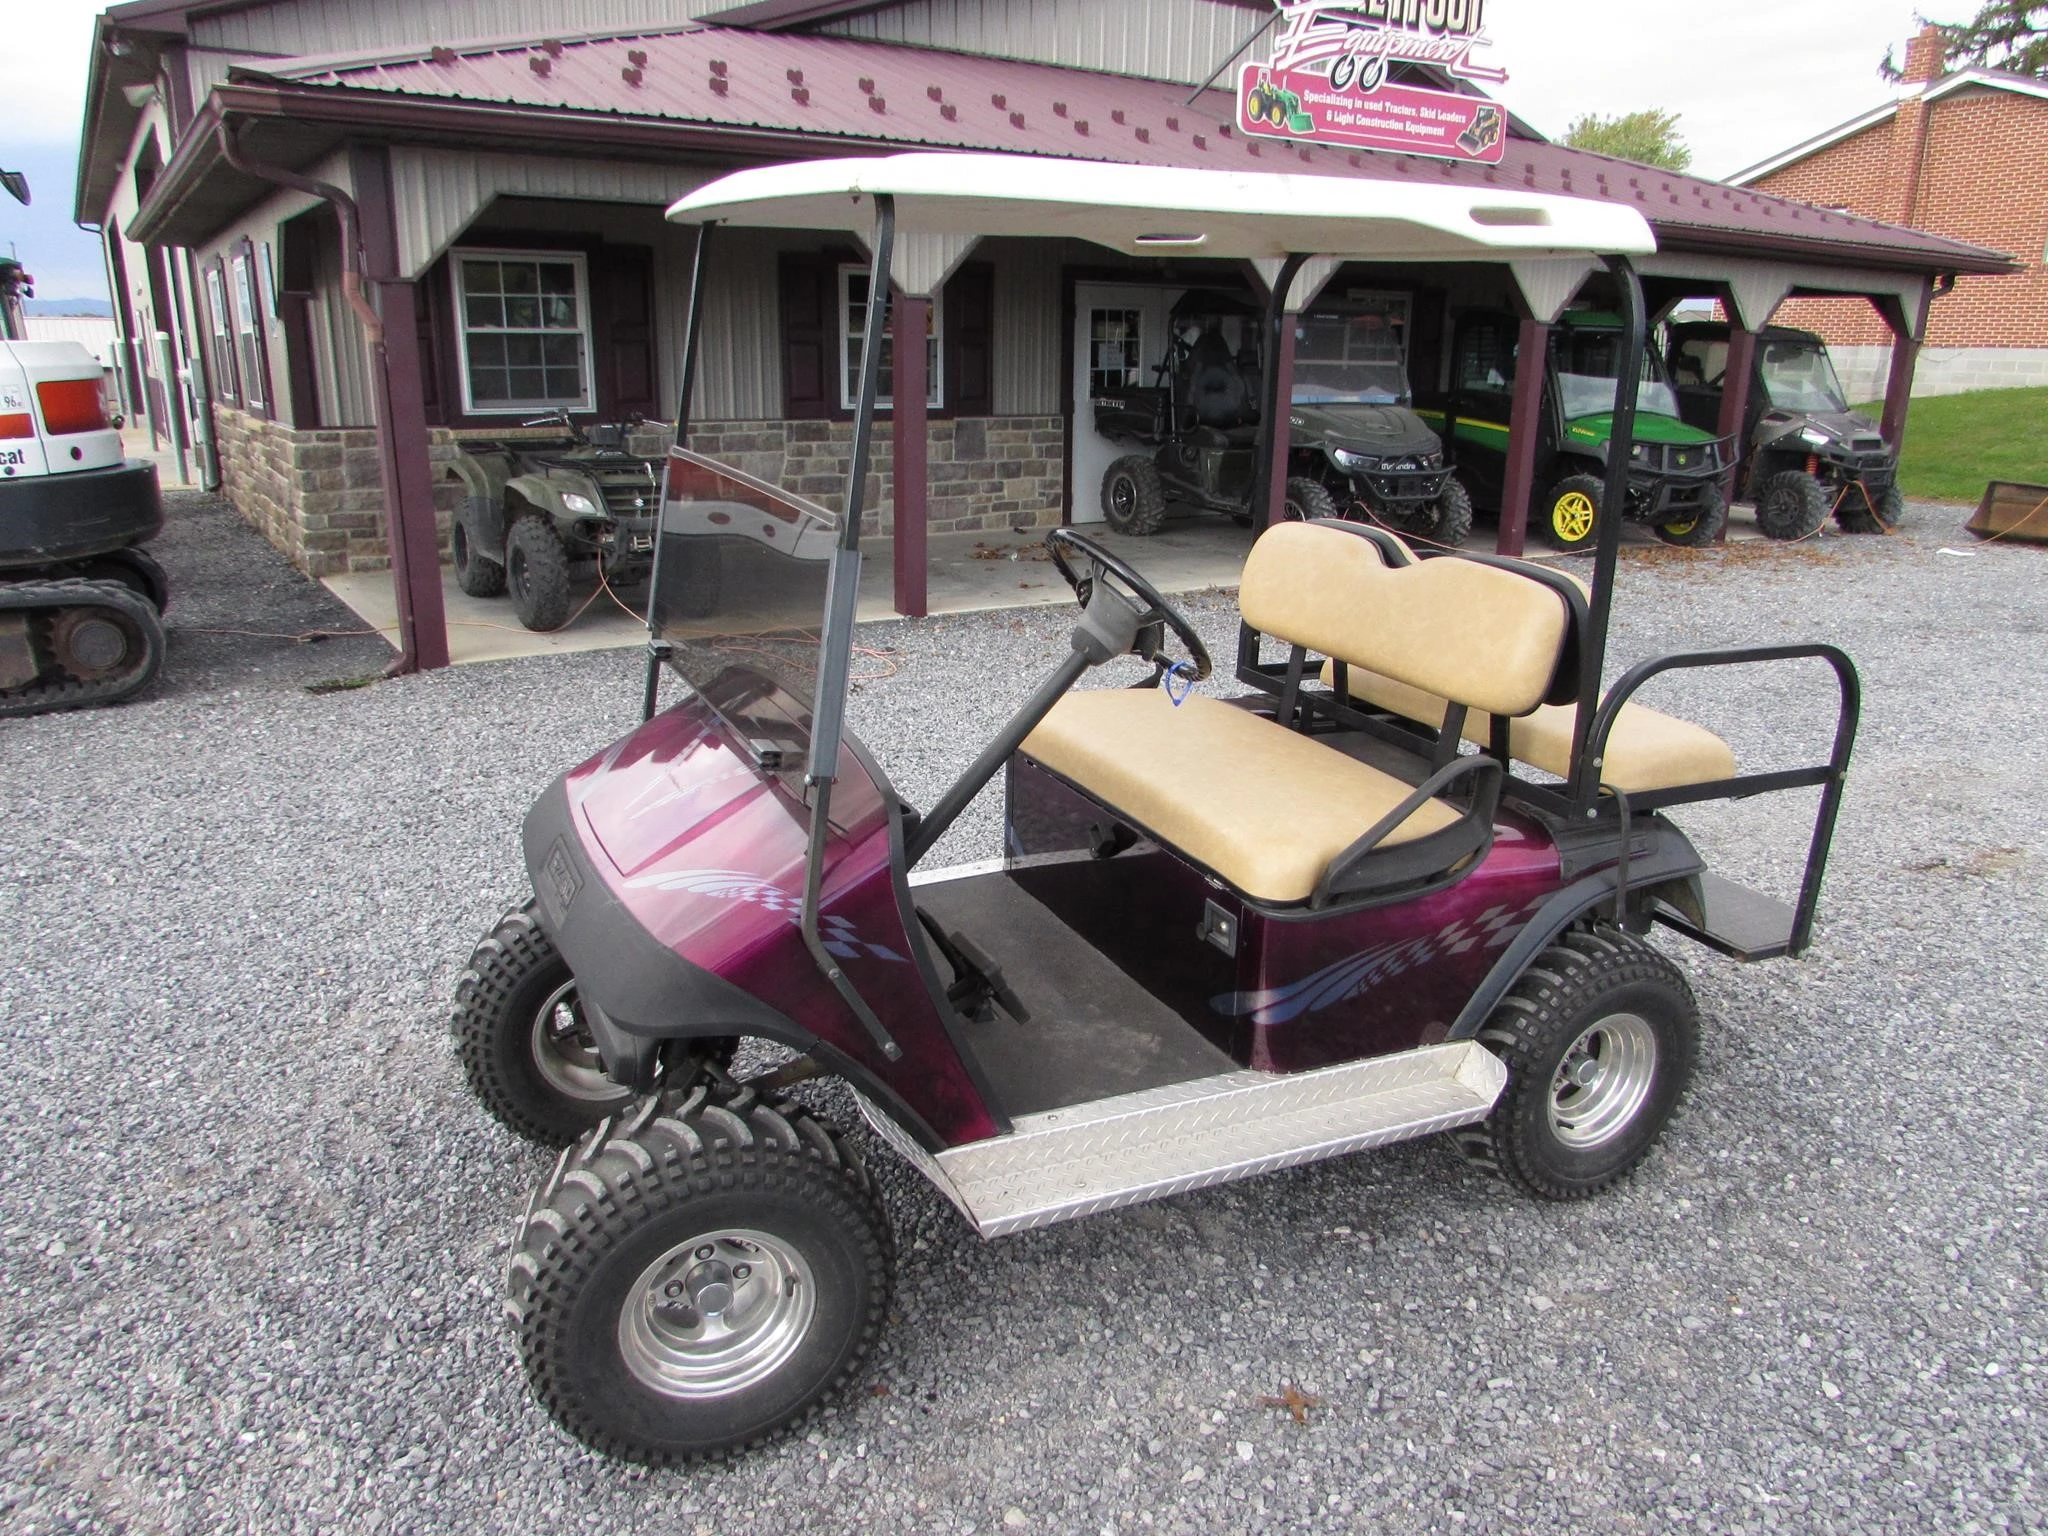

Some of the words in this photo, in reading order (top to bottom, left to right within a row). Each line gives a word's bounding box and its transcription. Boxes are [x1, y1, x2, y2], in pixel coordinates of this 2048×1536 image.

[1271, 0, 1507, 82] Equipment
[1303, 89, 1355, 110] Specializing
[1355, 99, 1363, 109] in
[1364, 101, 1383, 112] used
[1420, 107, 1437, 119] Skid
[1438, 110, 1467, 124] Loaders
[1334, 111, 1355, 126] Light
[1356, 114, 1404, 131] Construction
[1405, 121, 1446, 137] Equipment
